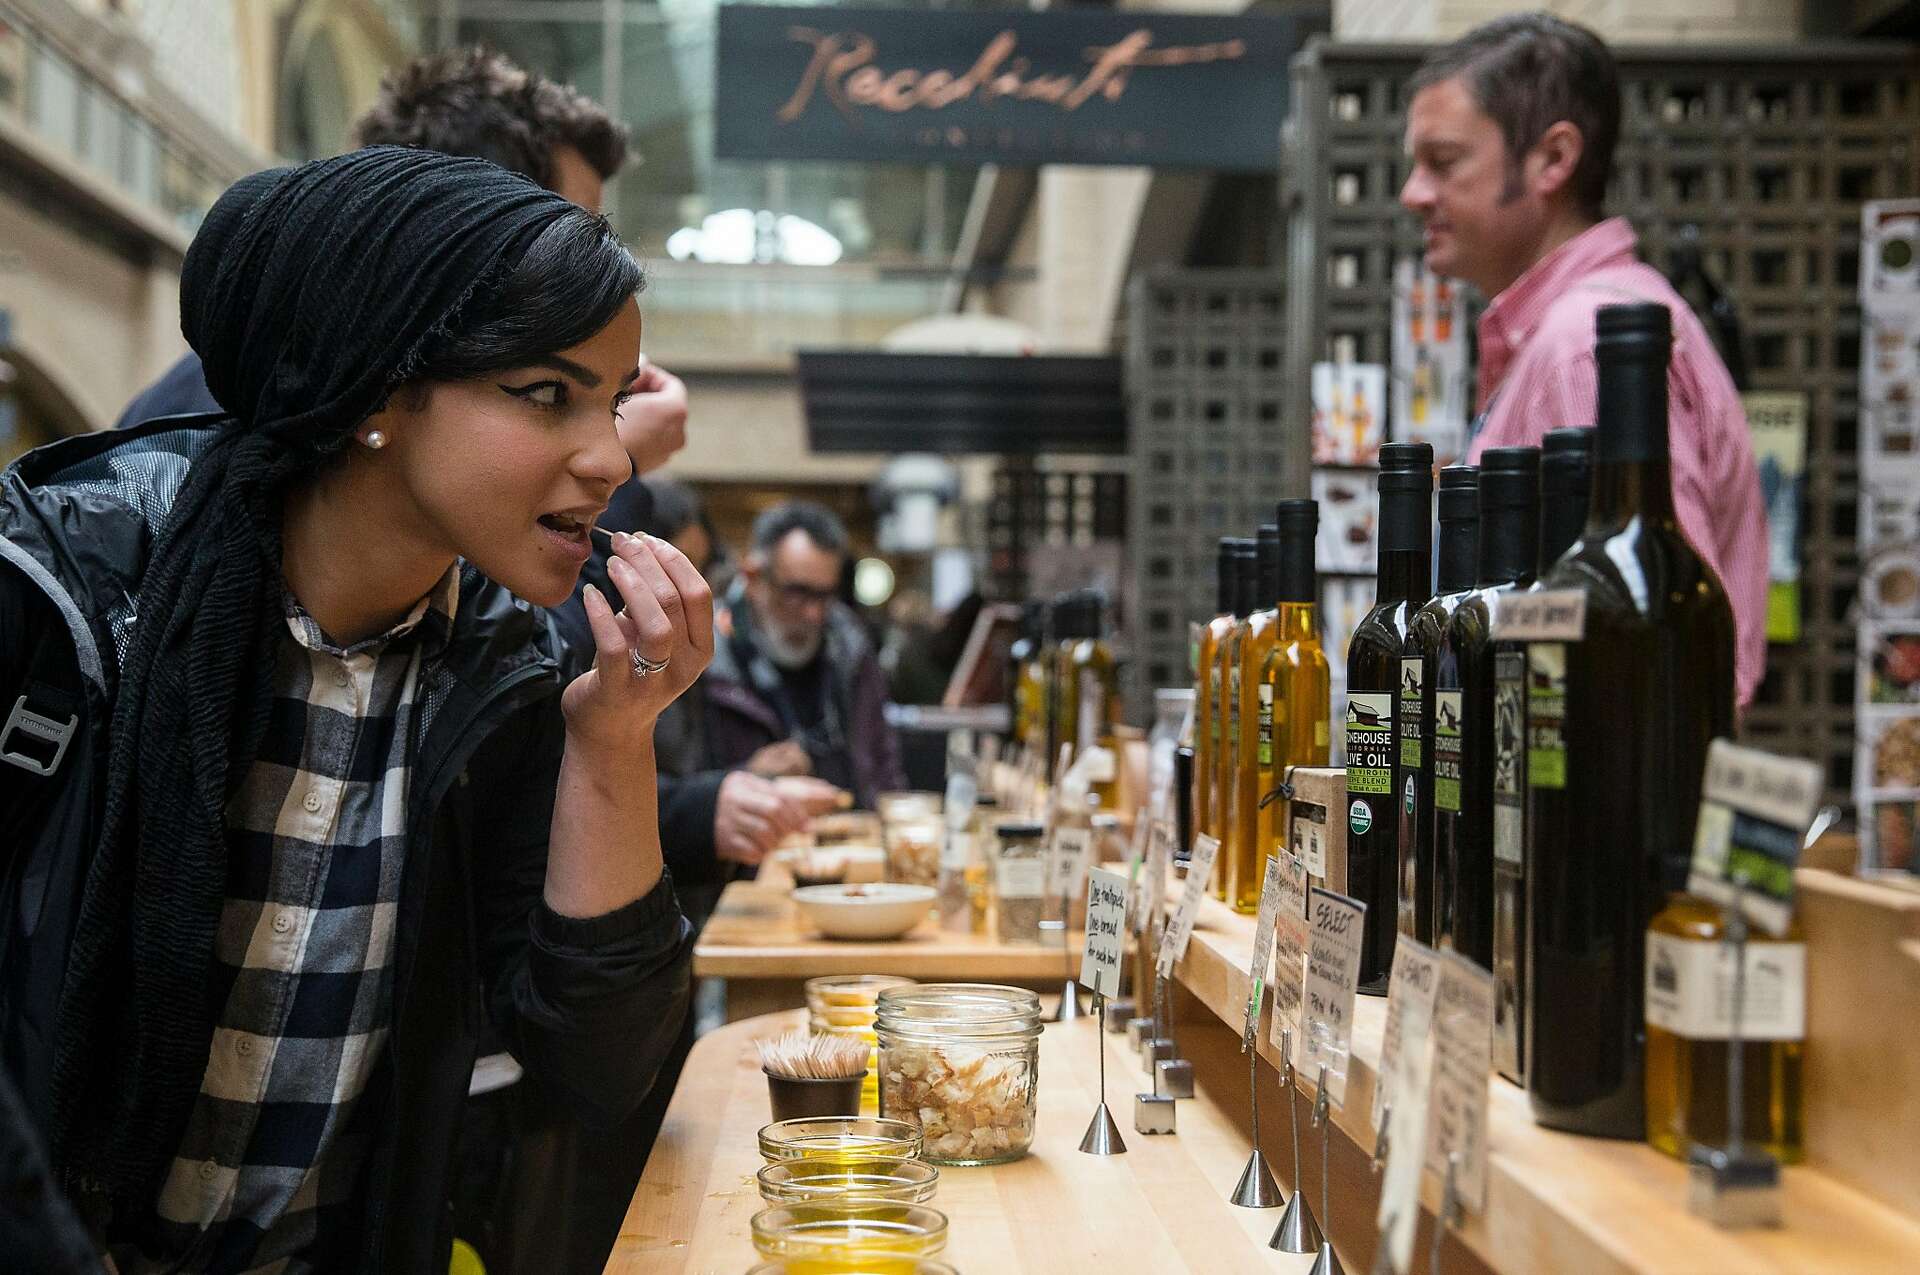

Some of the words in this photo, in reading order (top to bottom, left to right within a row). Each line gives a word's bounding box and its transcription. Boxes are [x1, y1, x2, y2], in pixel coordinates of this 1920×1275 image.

[1346, 732, 1391, 745] ONEHOUSE
[1346, 753, 1362, 766] LIVE
[1367, 754, 1391, 767] OIL
[1316, 902, 1355, 935] SELECT
